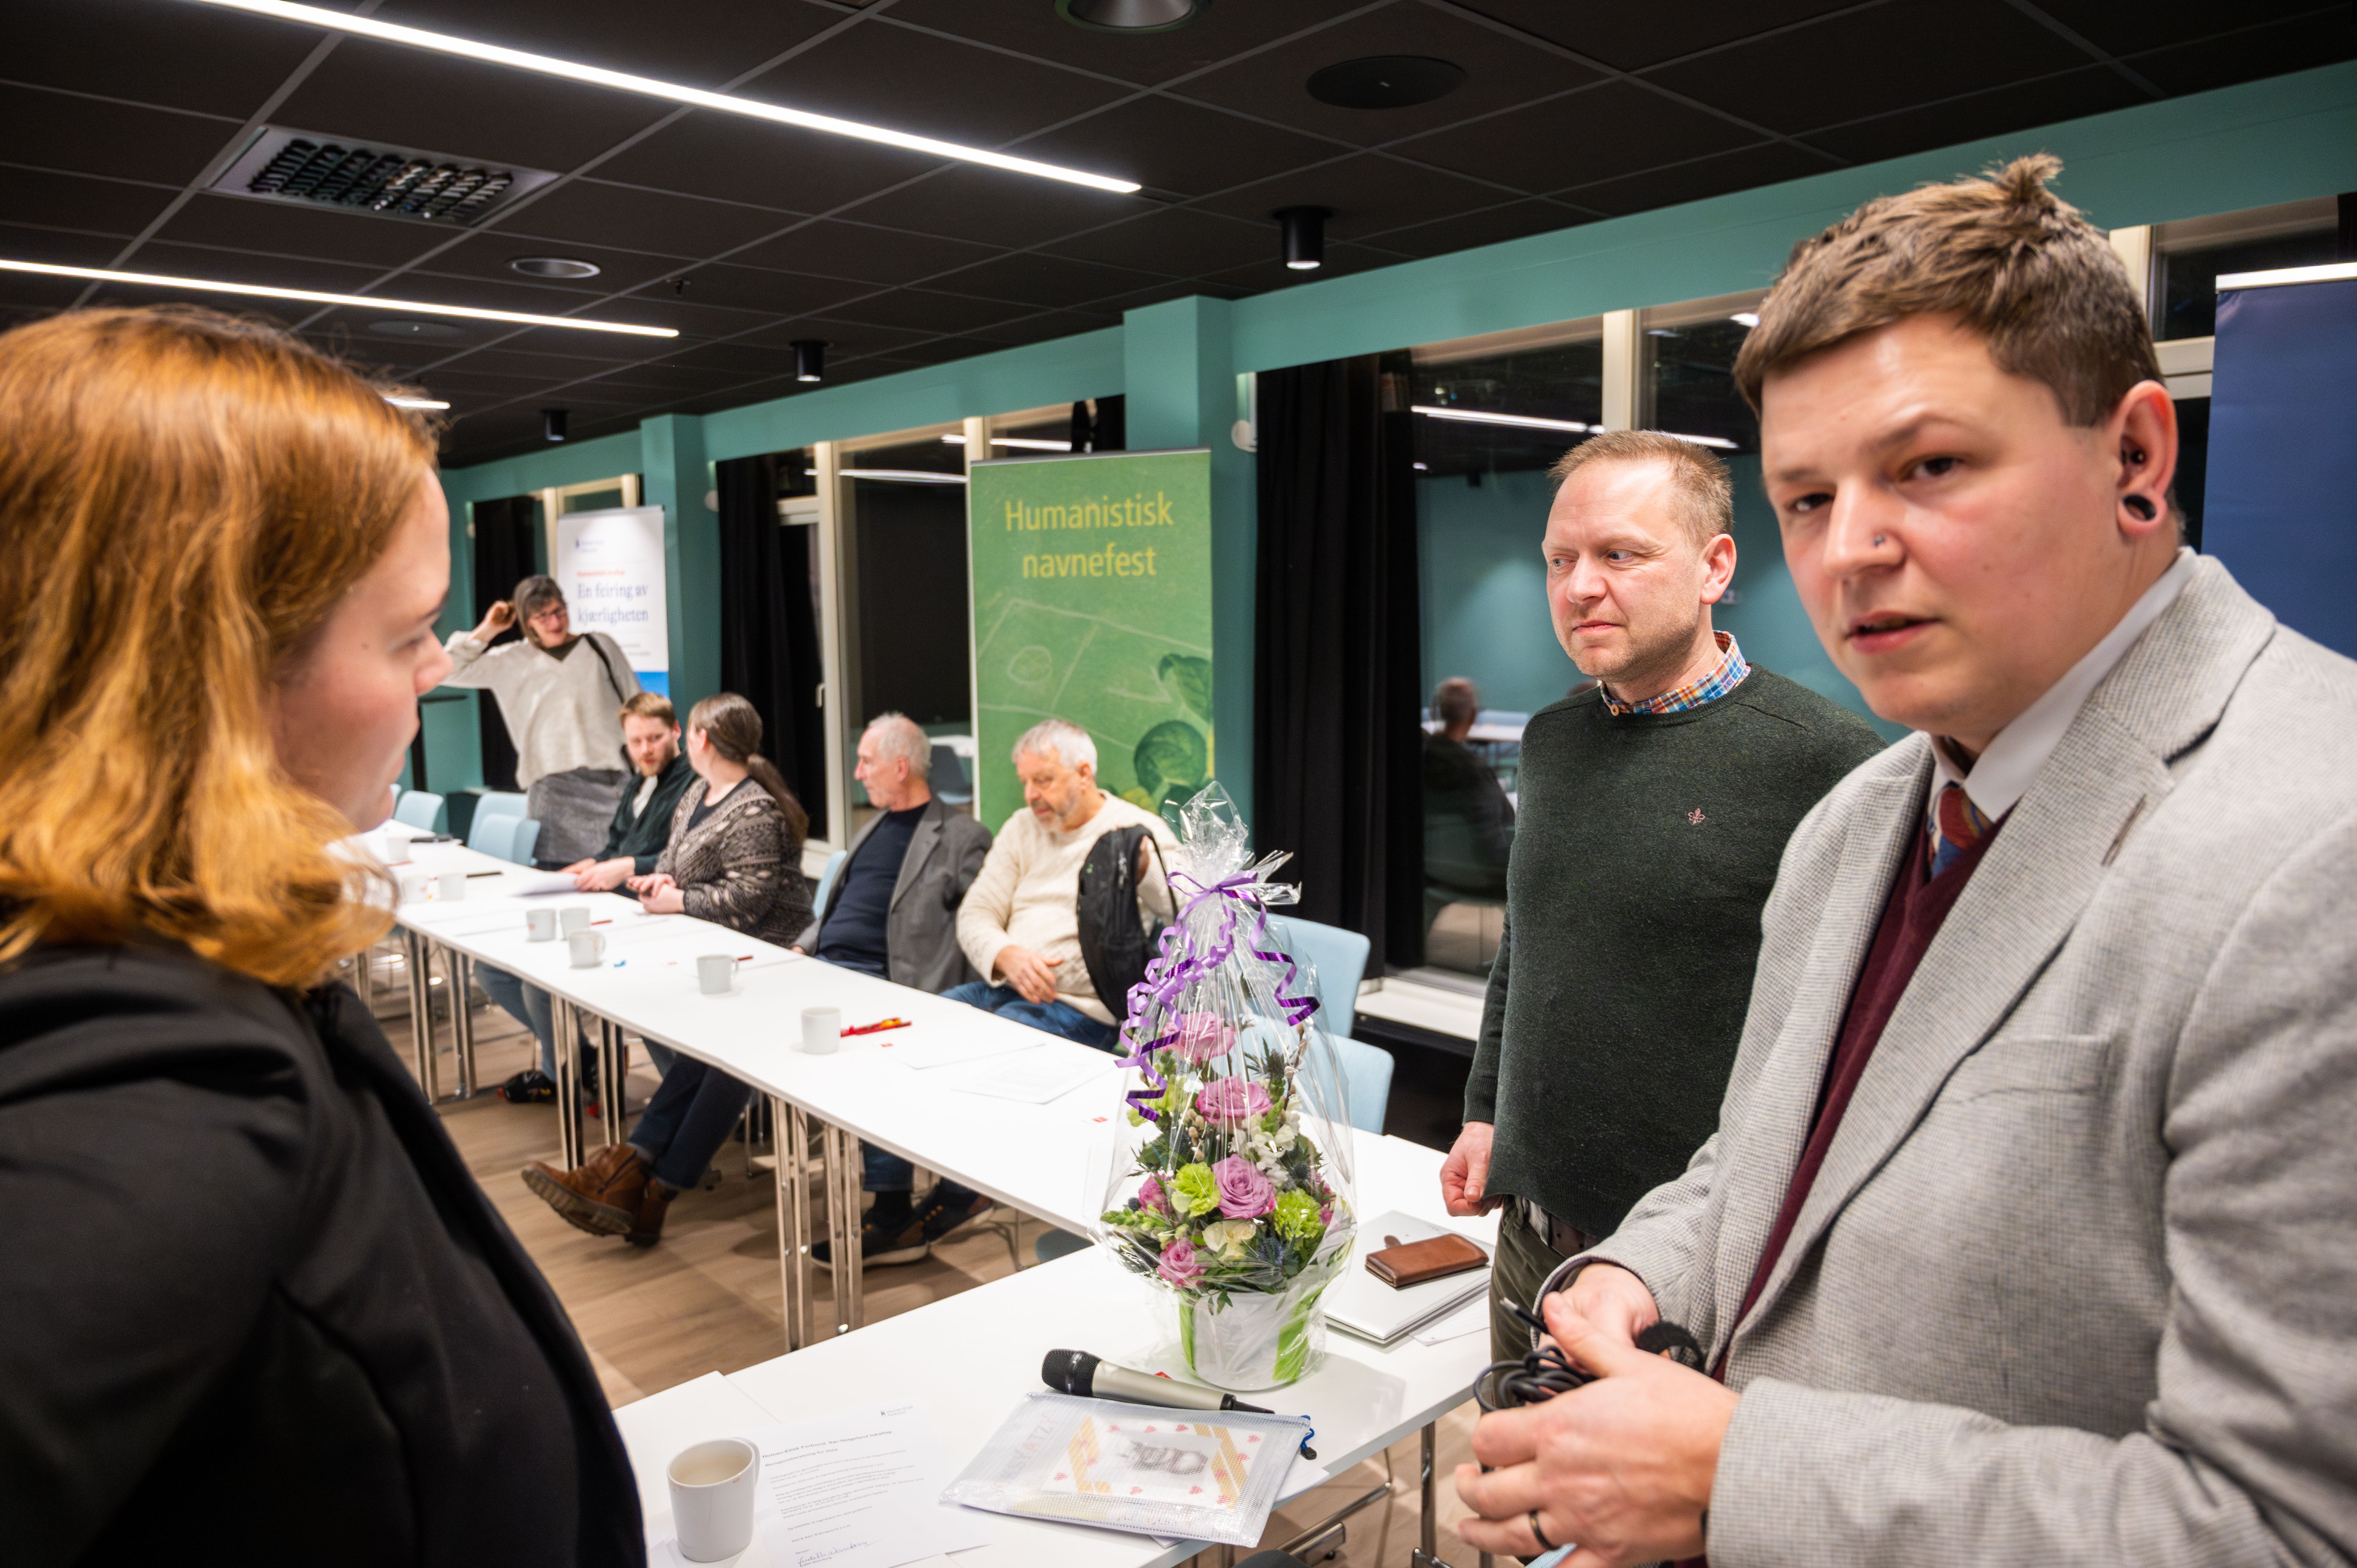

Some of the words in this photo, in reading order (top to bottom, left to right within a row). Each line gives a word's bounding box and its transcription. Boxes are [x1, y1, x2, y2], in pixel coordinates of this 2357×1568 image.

[1005, 491, 1174, 531] Humanistisk
[1022, 542, 1157, 579] navnefest
[577, 583, 592, 599] En
[595, 581, 633, 600] feiring
[636, 585, 648, 597] av
[578, 607, 648, 626] kjærligheten
